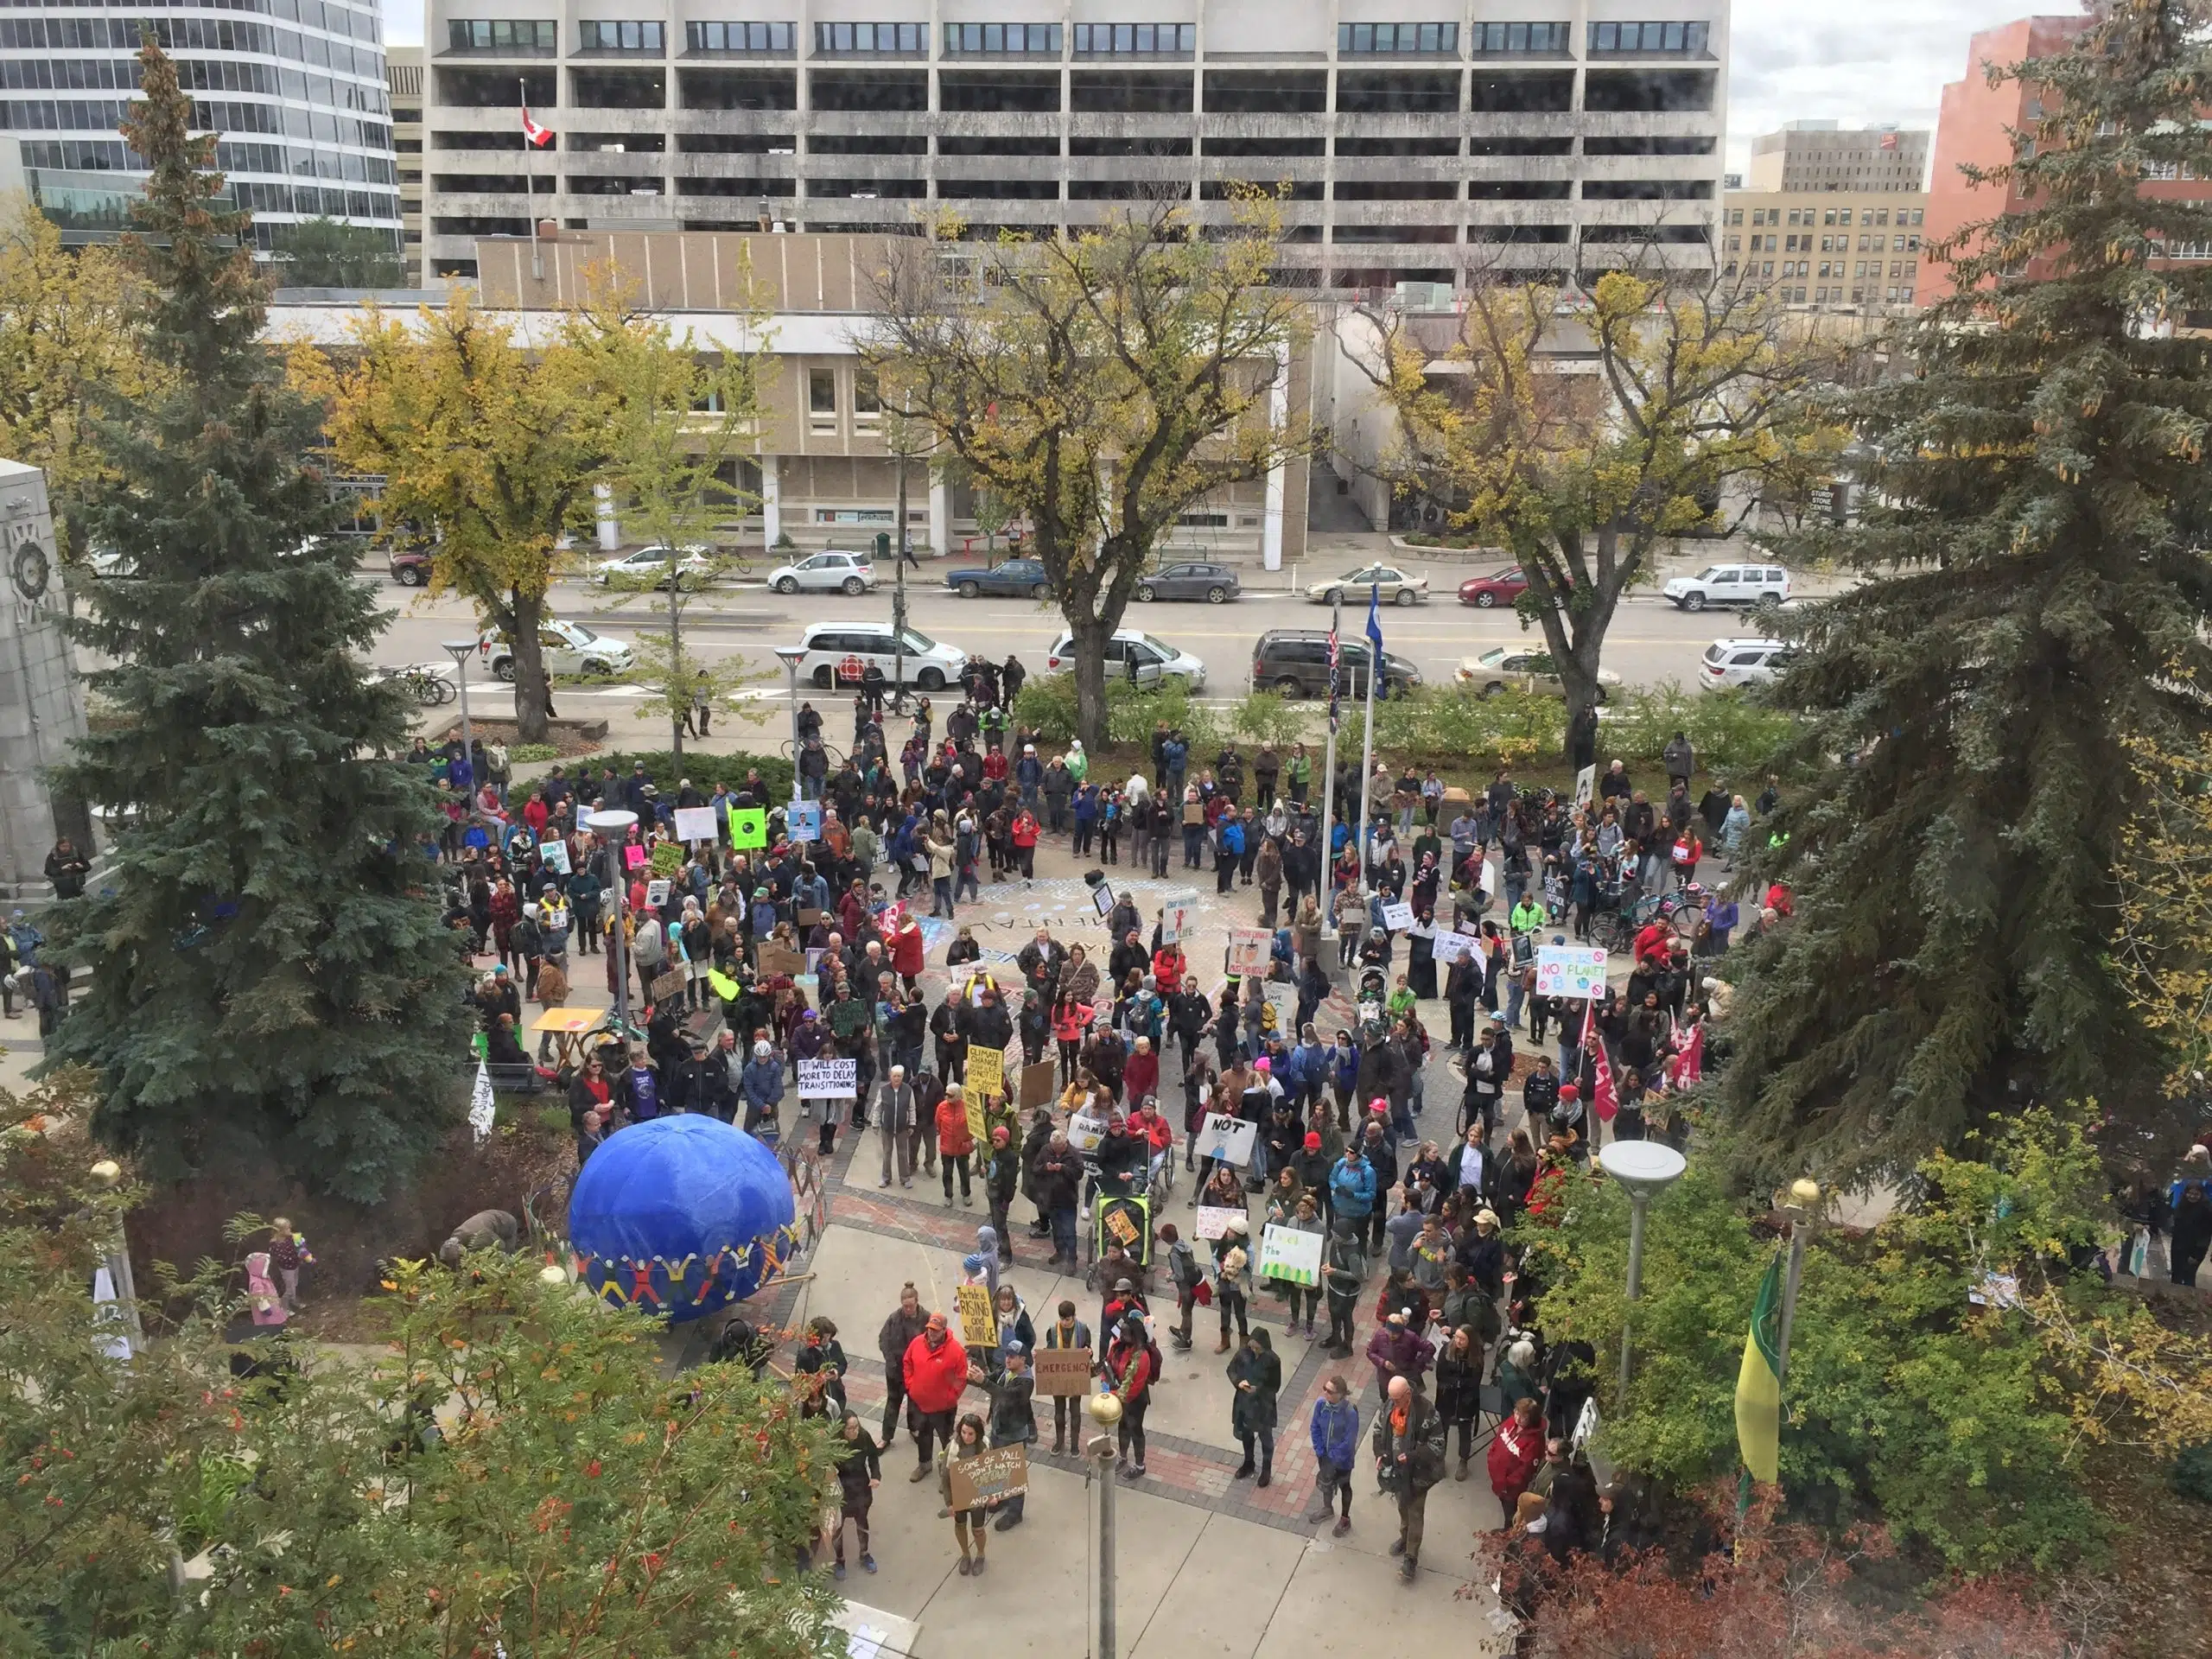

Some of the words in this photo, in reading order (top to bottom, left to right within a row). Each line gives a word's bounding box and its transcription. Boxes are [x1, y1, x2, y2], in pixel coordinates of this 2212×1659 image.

[1179, 926, 1193, 938] LIFE
[1541, 950, 1573, 962] THERE
[1576, 954, 1592, 964] IS
[1542, 963, 1560, 975] NO
[1567, 963, 1605, 977] PLANET
[1553, 976, 1564, 989] B
[970, 1047, 999, 1059] CLIMATE
[799, 1061, 808, 1071] IT
[812, 1061, 830, 1070] WILL
[834, 1060, 855, 1070] COST
[971, 1055, 997, 1067] CHANGE
[799, 1072, 820, 1081] MORE
[834, 1071, 855, 1080] DELAY
[798, 1081, 855, 1090] TRANSITIONING
[1211, 1119, 1246, 1134] NOT
[1265, 1244, 1280, 1255] the
[960, 1300, 989, 1317] RISING
[971, 1316, 985, 1325] and
[1036, 1362, 1089, 1373] EMERGENCY
[957, 1458, 980, 1474] SOME
[984, 1455, 995, 1465] OF
[968, 1465, 992, 1480] DIDN'T
[995, 1461, 1021, 1470] WATCH
[969, 1495, 988, 1505] AND
[991, 1491, 1003, 1500] IT
[1003, 1483, 1028, 1497] SHOWS
